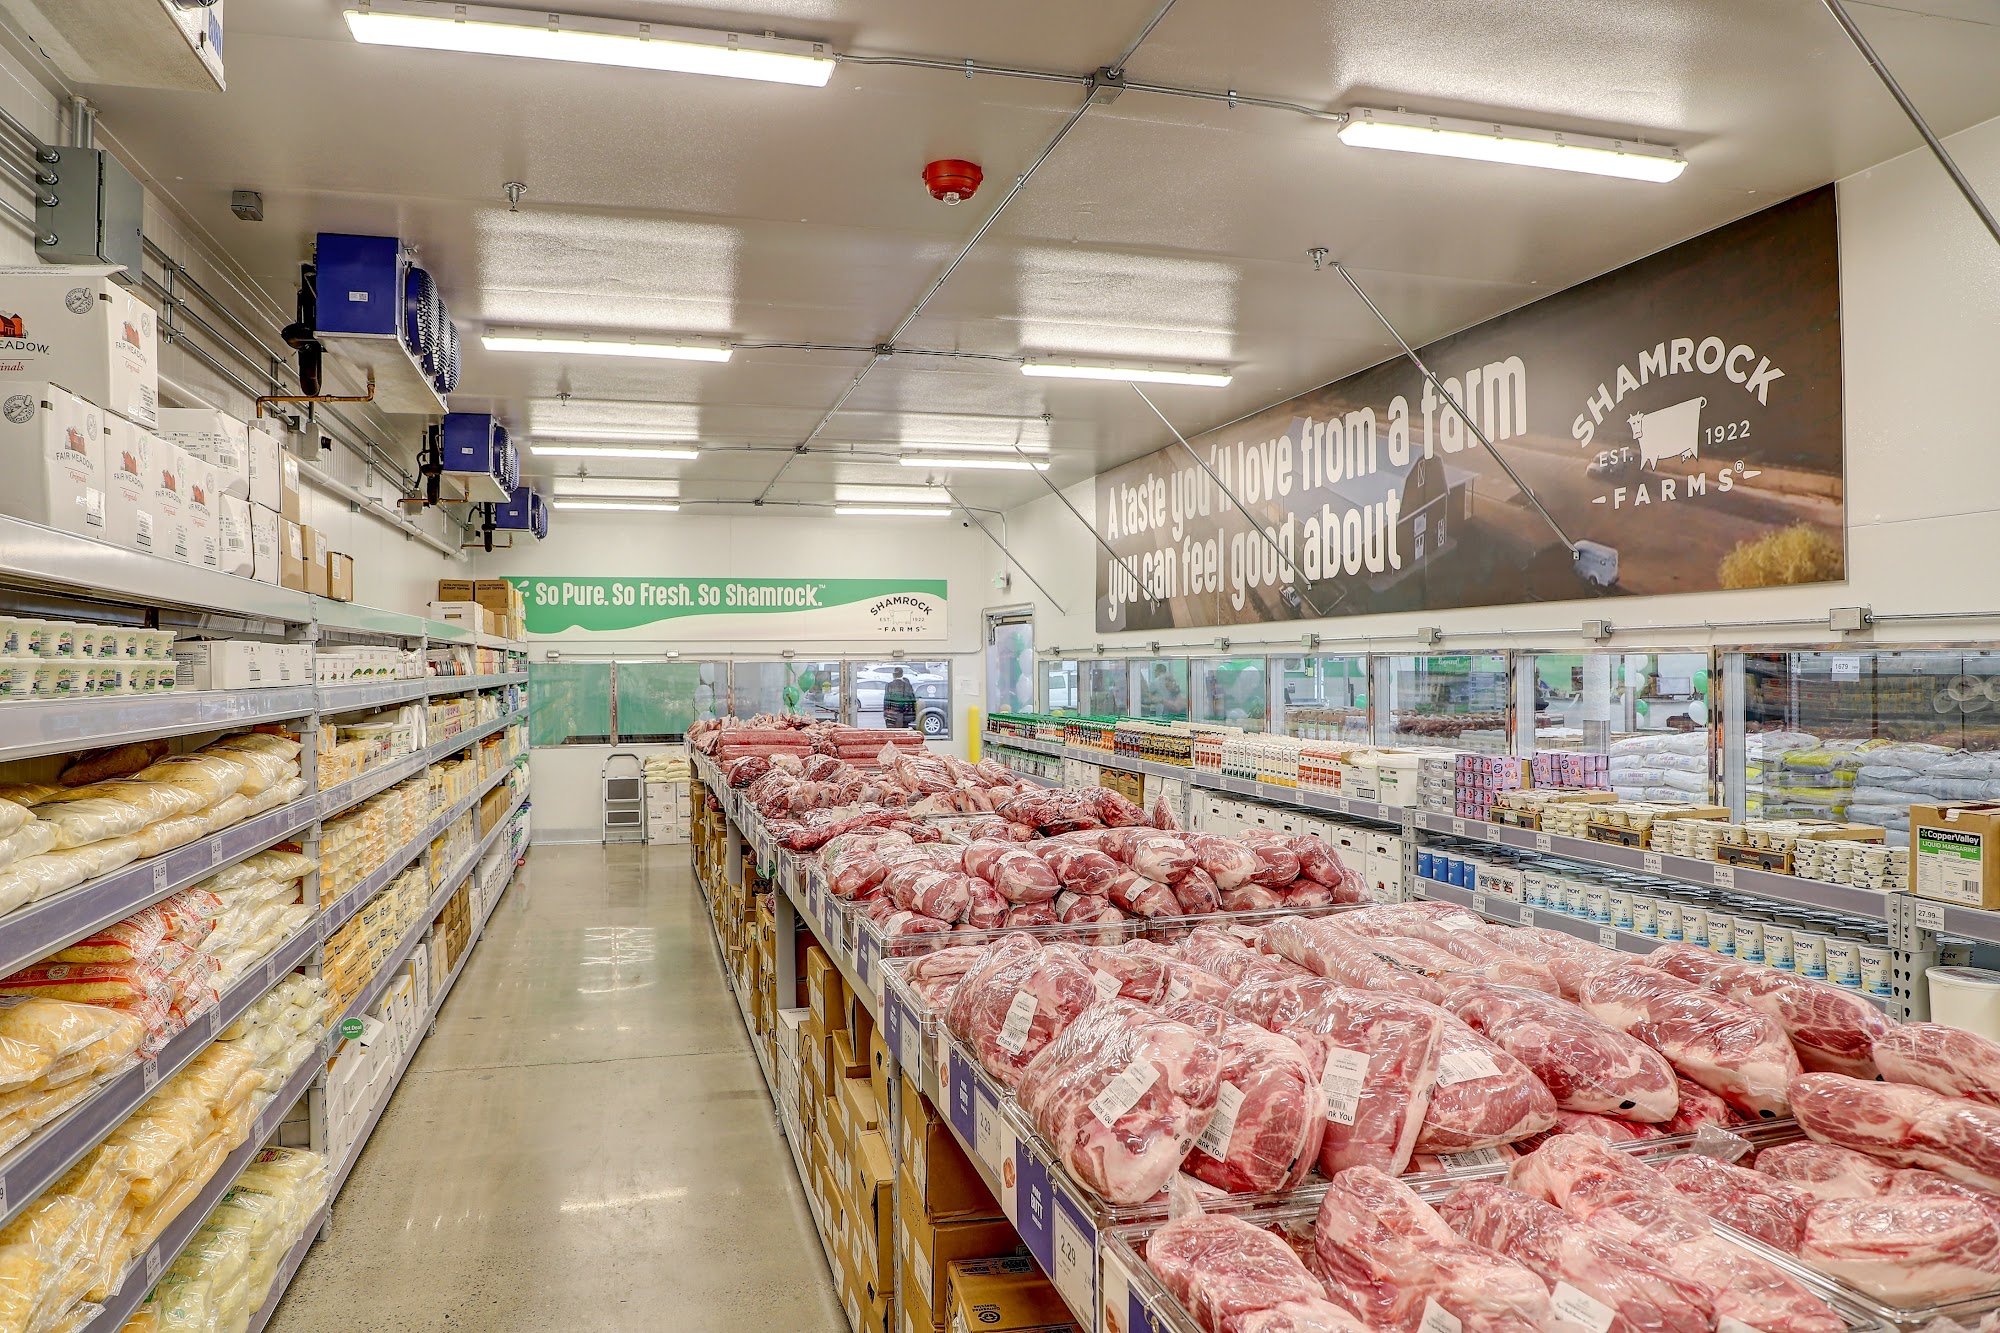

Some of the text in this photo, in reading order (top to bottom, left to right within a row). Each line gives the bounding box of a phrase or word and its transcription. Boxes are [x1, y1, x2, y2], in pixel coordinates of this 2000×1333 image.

[116, 341, 148, 365] FAIR MEADOW
[1572, 336, 1785, 448] SHAMROCK
[1108, 356, 1526, 542] A taste you'll love from a farm
[1600, 419, 1750, 468] EST. 1922
[56, 452, 94, 472] FAIR MEADOW
[125, 474, 144, 490] MEADOW
[1108, 489, 1401, 622] you can feel good about
[536, 582, 559, 606] So
[562, 582, 609, 606] Pure.
[612, 583, 635, 606] So
[640, 583, 694, 606] Fresh.
[698, 584, 720, 606] So
[870, 596, 932, 616] SHAMROCK
[1928, 830, 1979, 845] CopperValley
[1941, 843, 1977, 854] MARGARINE
[155, 866, 166, 879] 24.99
[1918, 909, 1936, 918] 27.99
[145, 1061, 156, 1077] 24.99
[1092, 1100, 1113, 1124] Thank You
[1340, 1111, 1352, 1121] You
[980, 1112, 991, 1136] 2.29
[1212, 1145, 1224, 1158] You
[1030, 1193, 1043, 1219] BUTT
[1060, 1234, 1076, 1267] 2.29
